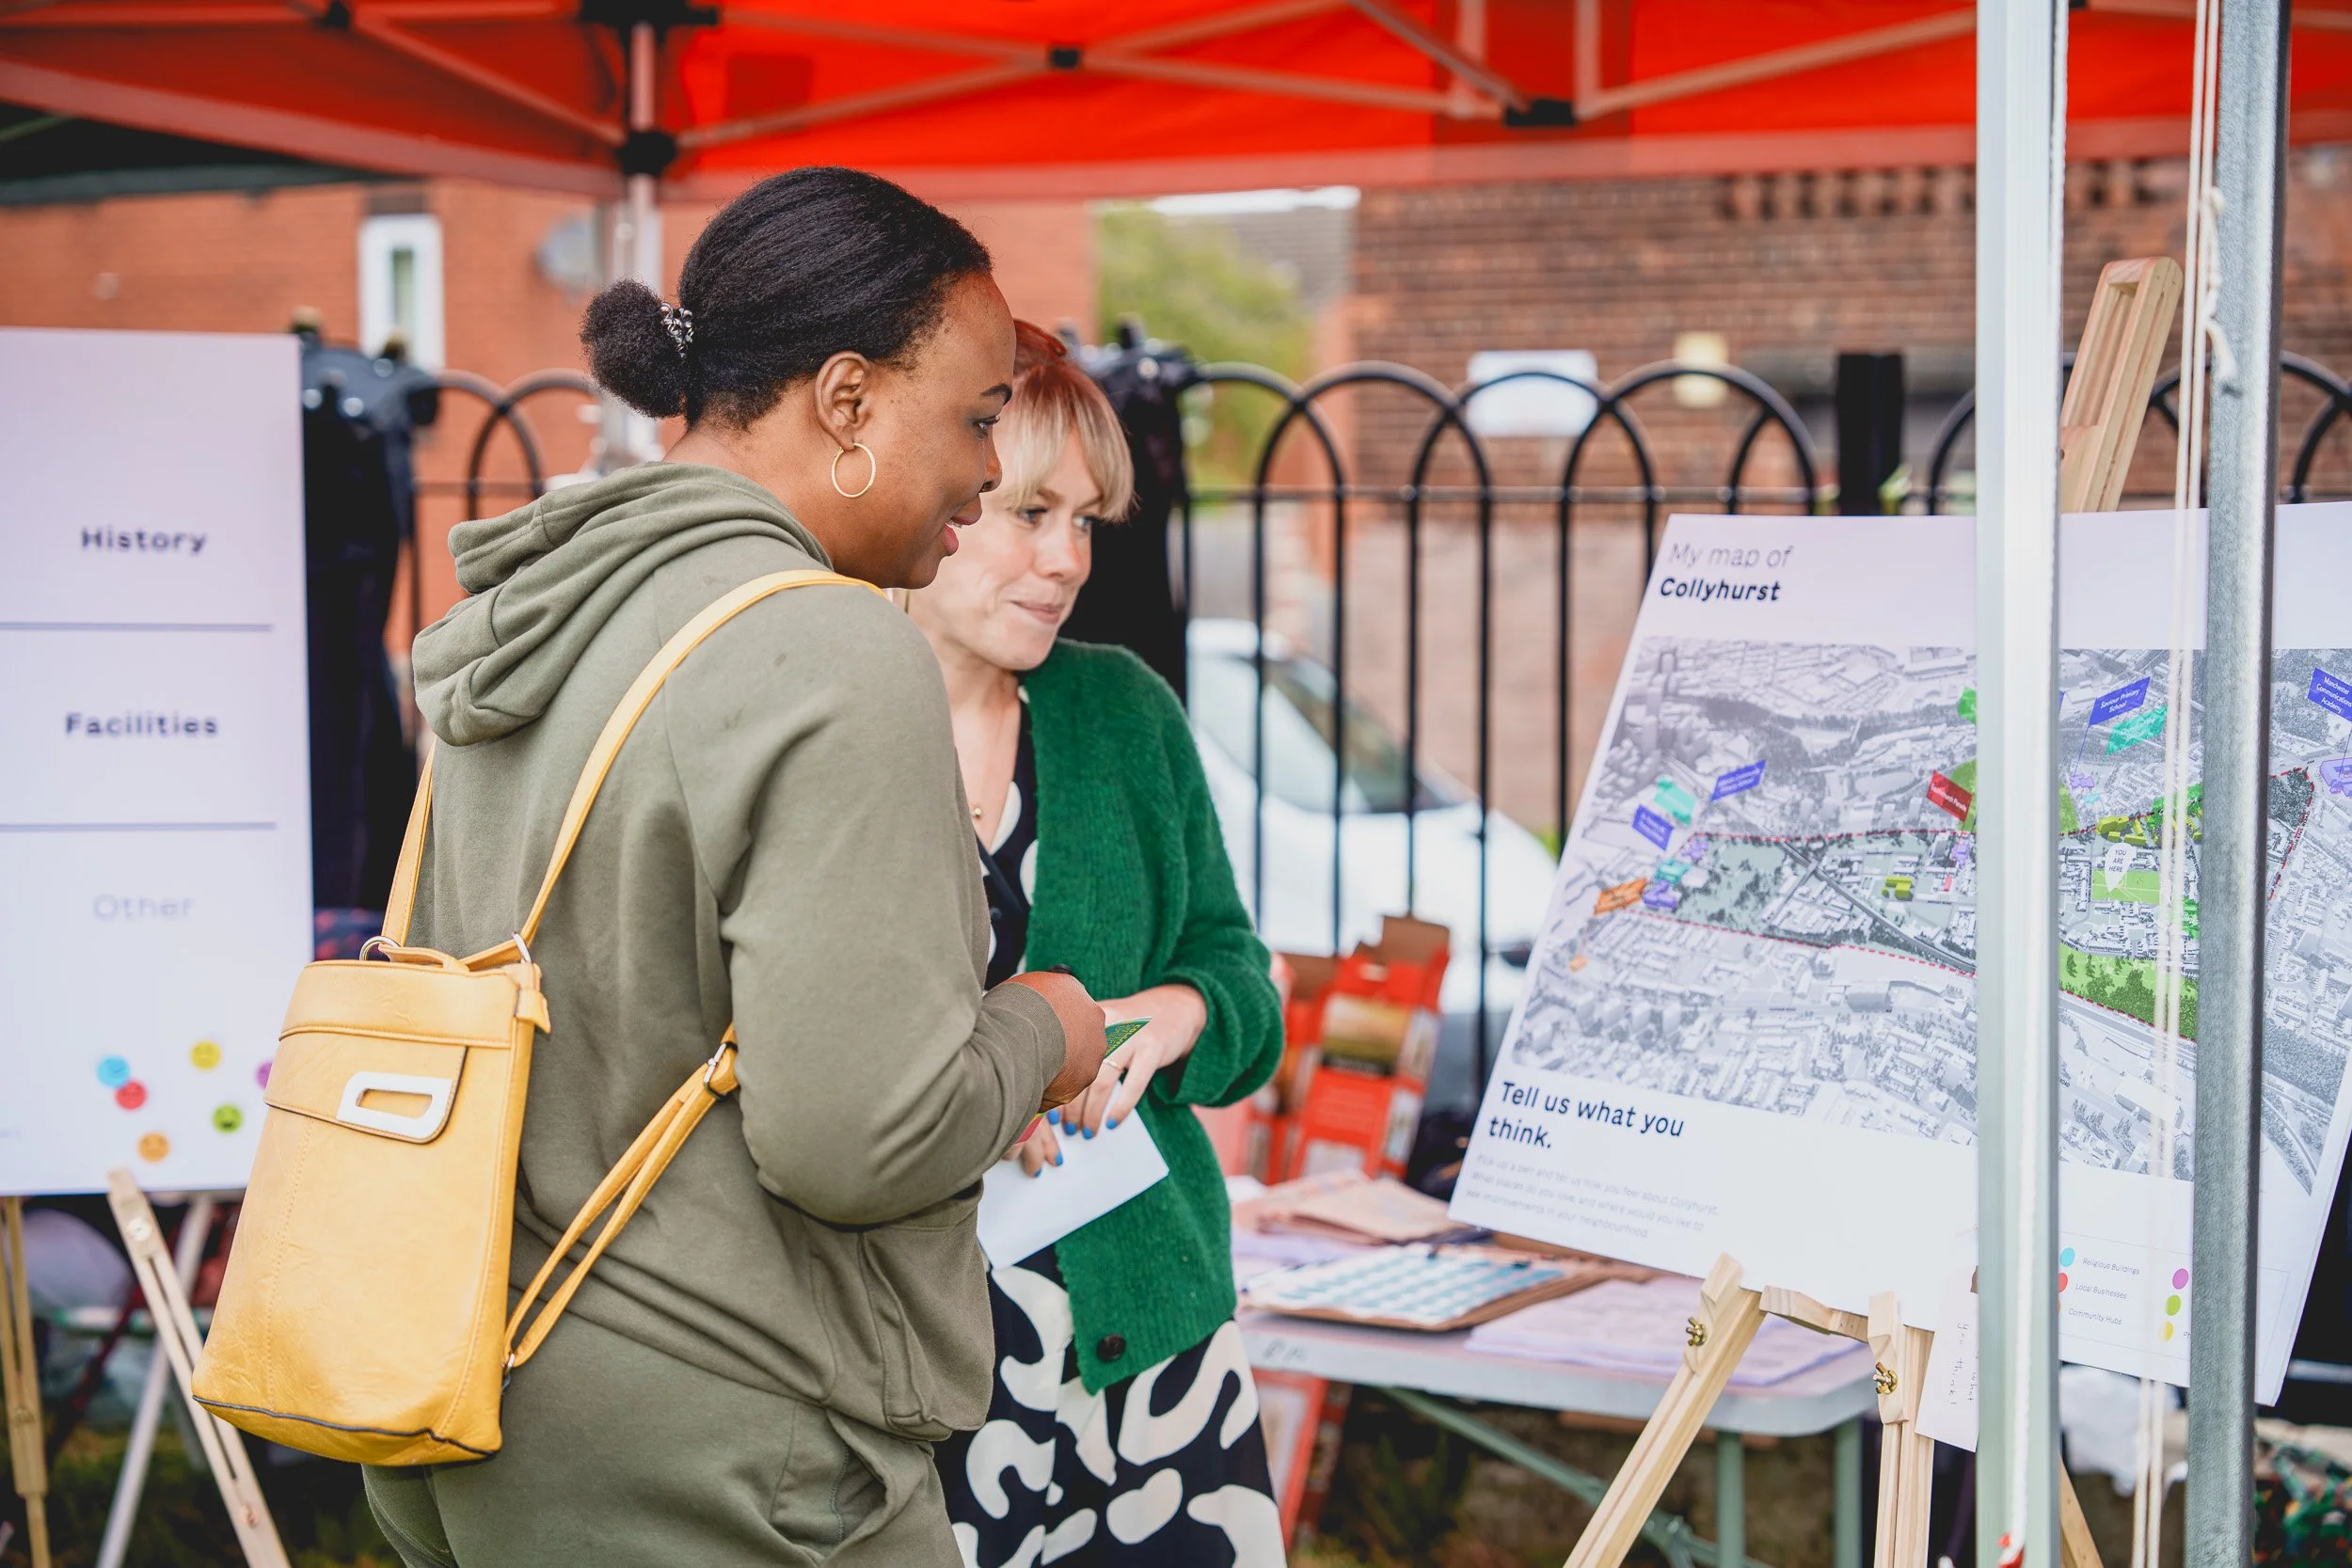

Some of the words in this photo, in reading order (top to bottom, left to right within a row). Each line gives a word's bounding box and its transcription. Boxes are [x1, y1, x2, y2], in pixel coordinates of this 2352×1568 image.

[80, 525, 207, 556] History
[1667, 542, 1701, 568] My
[1708, 546, 1760, 569] map
[1766, 544, 1794, 568] of
[1661, 578, 1781, 602] Collyhurst
[2316, 684, 2352, 707] Communications
[2324, 676, 2350, 695] Manchester
[2100, 696, 2120, 709] Saviour
[2120, 689, 2140, 702] Primary
[2108, 701, 2127, 713] School
[2321, 697, 2343, 714] Academy
[65, 710, 218, 737] Facilities
[92, 893, 196, 922] Other
[1501, 1081, 1539, 1109] Tell
[1544, 1094, 1570, 1116] us
[1577, 1101, 1636, 1128] what
[1640, 1113, 1685, 1138] you
[1488, 1117, 1552, 1148] think.
[1603, 1183, 1620, 1195] you
[1642, 1191, 1669, 1204] about
[1597, 1201, 1626, 1214] where
[1628, 1208, 1656, 1221] would
[1657, 1214, 1674, 1226] you
[1676, 1217, 1692, 1229] like
[1693, 1220, 1705, 1232] to
[2082, 1258, 2110, 1273] Religious
[2111, 1261, 2140, 1275] Buildings
[2075, 1282, 2091, 1293] Local
[2092, 1285, 2127, 1300] Businesses
[2068, 1307, 2105, 1323] Community
[2106, 1313, 2122, 1325] Hubs
